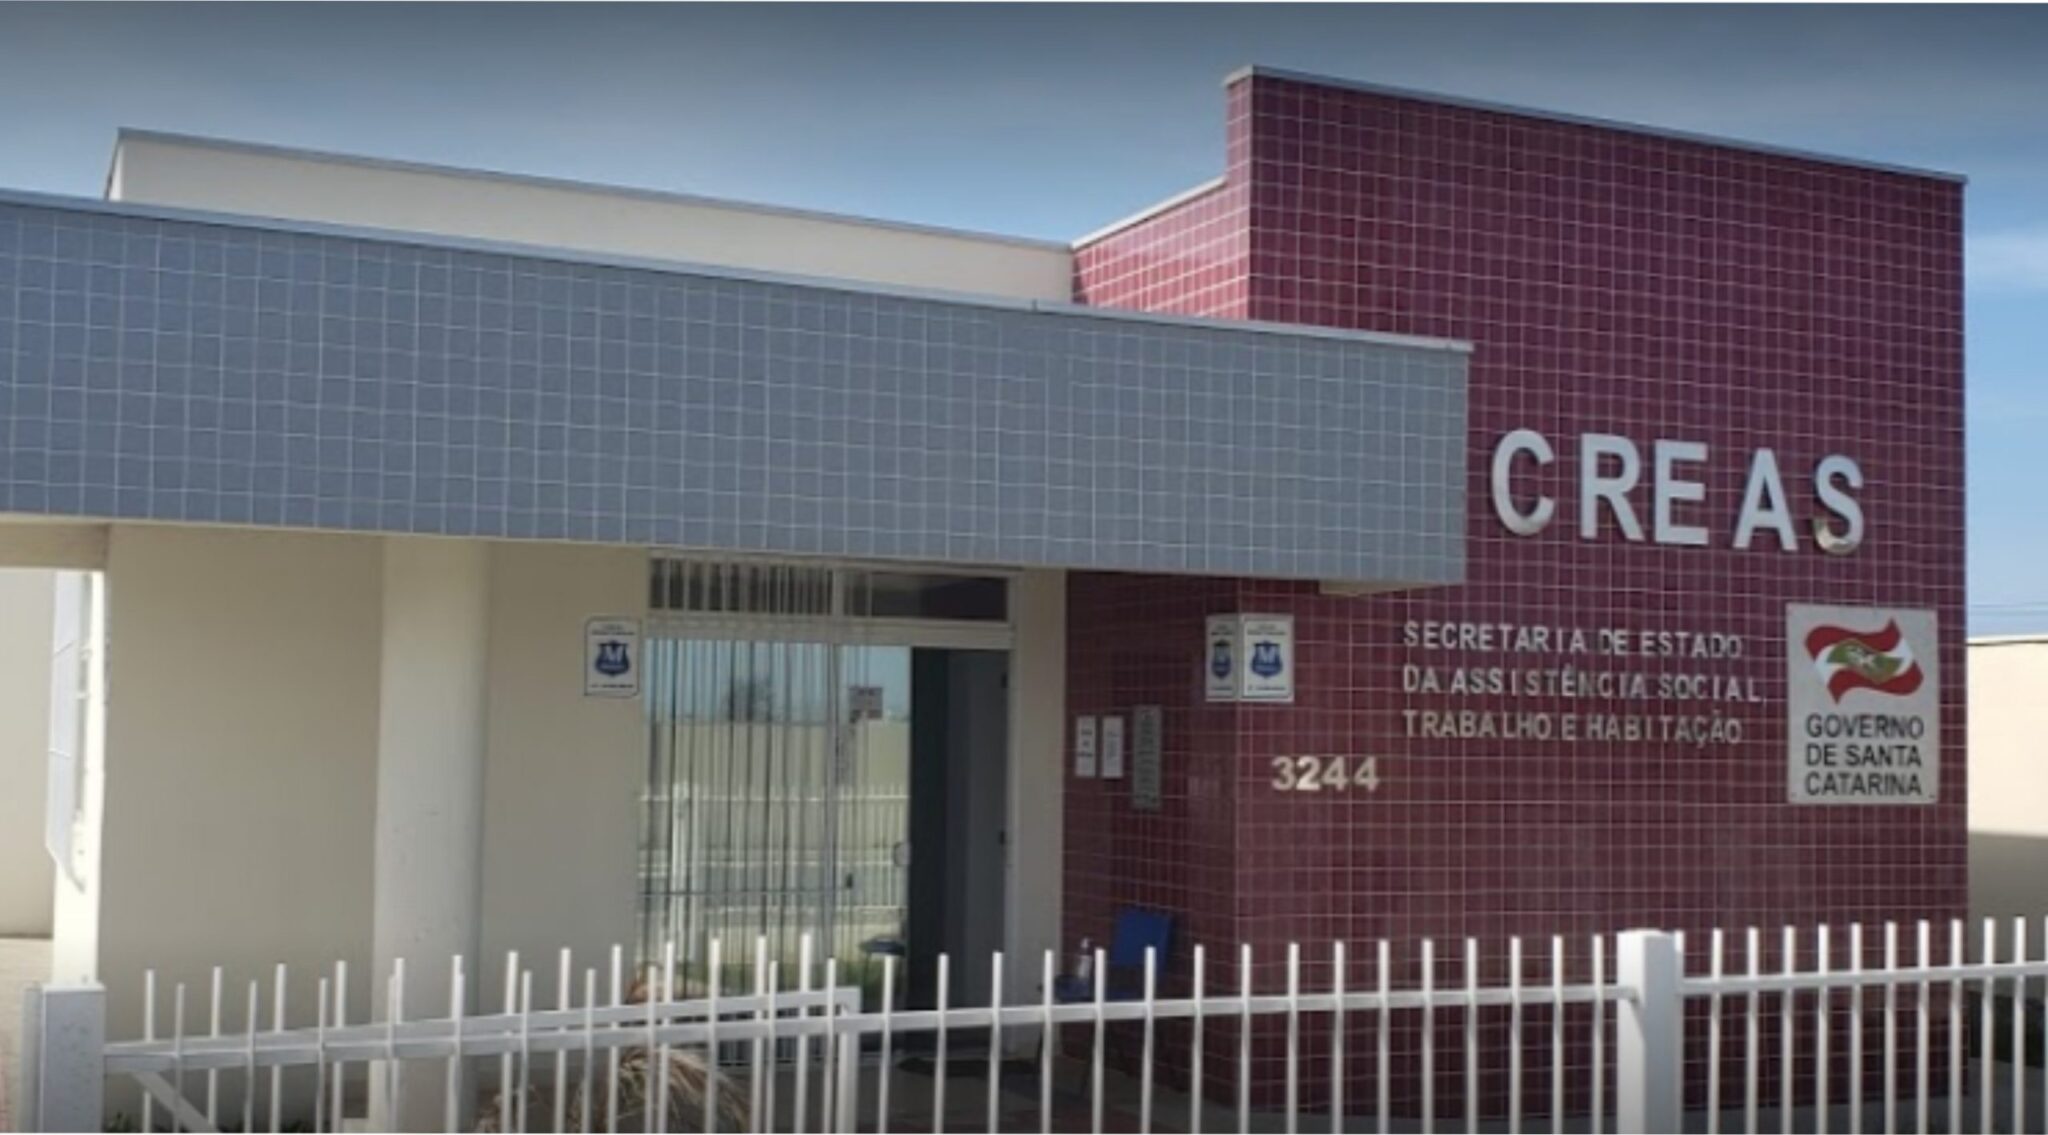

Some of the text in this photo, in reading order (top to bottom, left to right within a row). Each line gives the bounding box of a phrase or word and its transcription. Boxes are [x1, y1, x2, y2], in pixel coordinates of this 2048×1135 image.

[1491, 428, 1864, 555] CREAS
[1403, 620, 1742, 658] SECRETARIA DE ESTADO
[1403, 664, 1441, 694] DA
[1450, 664, 1648, 699] ASSISTÊNCIA
[1402, 709, 1742, 749] TRABALHO E HABITAÇÃO
[1805, 713, 1925, 740] GOVERNO
[1806, 743, 1922, 768] DE SANTA
[1272, 756, 1380, 791] 3244
[1805, 771, 1922, 797] CATARINA
